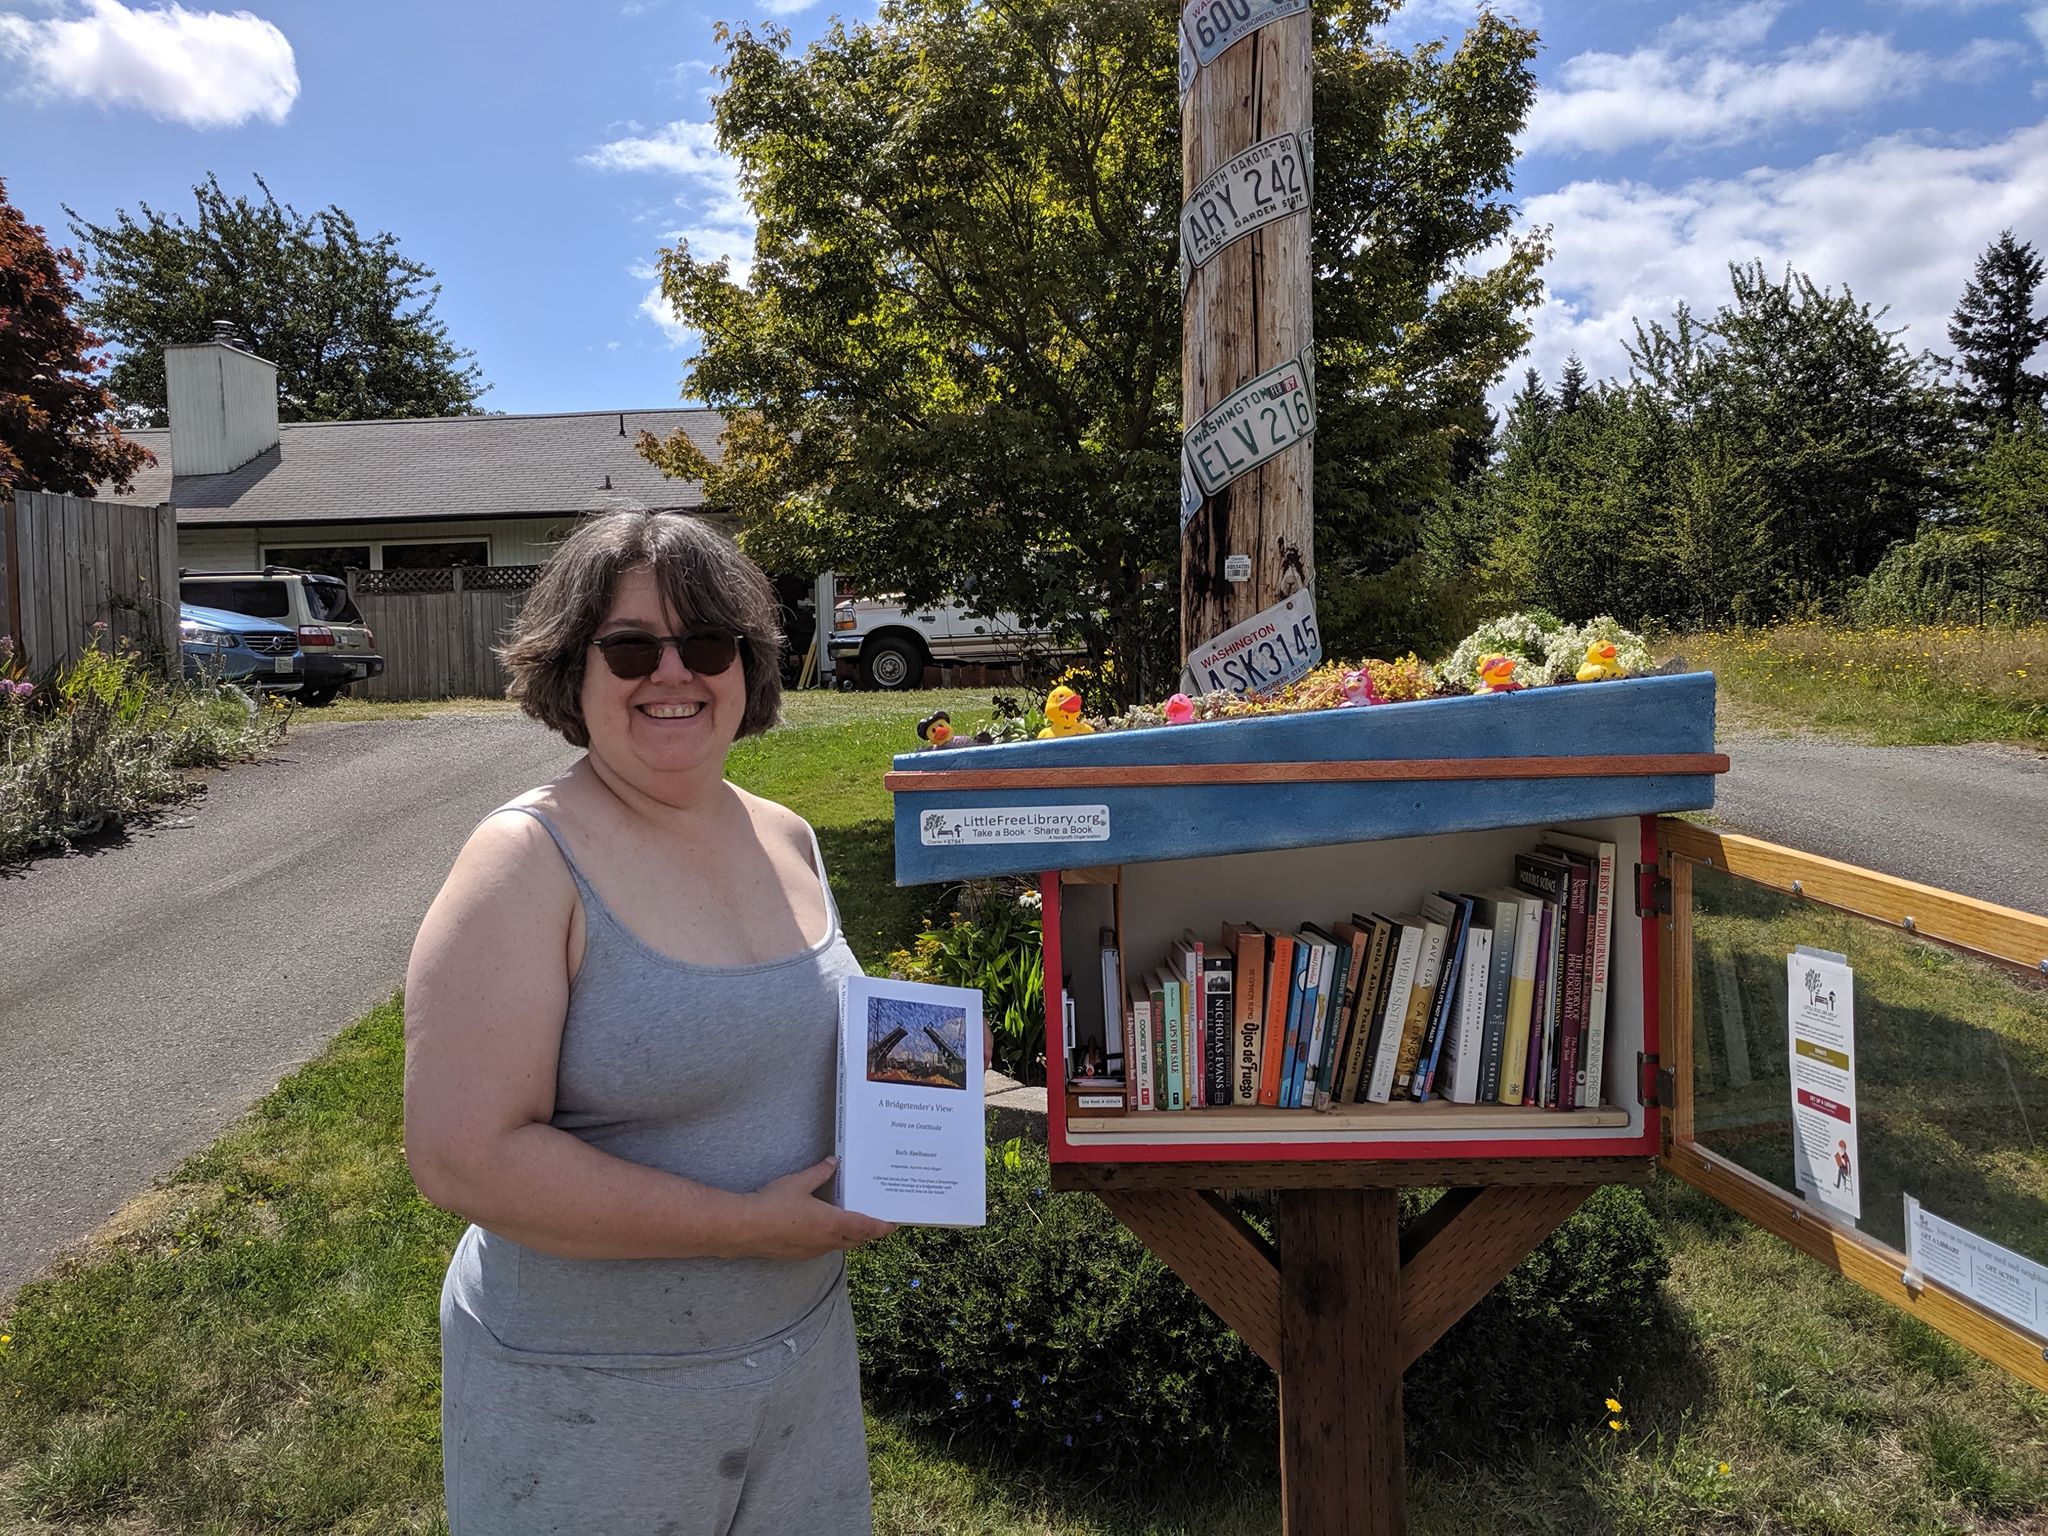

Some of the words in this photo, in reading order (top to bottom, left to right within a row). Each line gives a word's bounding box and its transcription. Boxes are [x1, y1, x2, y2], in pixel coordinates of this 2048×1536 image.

[1232, 10, 1275, 37] EVERGREEN
[1199, 171, 1228, 199] NORTH
[1231, 148, 1272, 174] DAKOTA
[1190, 183, 1238, 249] ARY
[1244, 154, 1301, 206] 242
[1198, 229, 1228, 256] PEACE
[1234, 203, 1277, 228] GARDEN
[1191, 387, 1270, 447] WASHINGTON
[1197, 419, 1259, 483] ELV
[1260, 390, 1309, 445] 216
[1201, 623, 1275, 669] WASHINGTON
[1208, 614, 1317, 694] ASK3145
[1291, 663, 1308, 678] STATE
[964, 813, 1100, 827] LittleFreeLibrary.org
[972, 828, 993, 838] Take
[1003, 827, 1025, 836] Book
[1034, 825, 1060, 836] Share
[1070, 825, 1093, 834] Book
[1600, 855, 1611, 874] THE
[1571, 879, 1580, 909] Newhall
[1578, 879, 1588, 914] Beaumont
[1599, 875, 1609, 895] BEST
[1598, 896, 1609, 908] OF
[1585, 914, 1596, 954] HENRY'S
[1373, 927, 1387, 972] Angela's
[1427, 937, 1440, 963] DAVE
[1499, 951, 1508, 974] SAND
[1575, 953, 1584, 971] THE
[1338, 973, 1347, 996] BELIEVE
[1366, 973, 1377, 1001] Ashes
[1395, 957, 1411, 995] WEIRD
[1422, 968, 1433, 990] ISAY
[1565, 953, 1576, 1020] PHOTOGRAPHY
[1573, 973, 1582, 1007] HISTORY
[1247, 1001, 1255, 1020] KING
[1465, 986, 1474, 1013] falling
[1475, 991, 1483, 1030] guterson
[1496, 992, 1504, 1008] FOG
[1555, 981, 1563, 1028] EXPERIMENTS
[1168, 1019, 1178, 1038] CAPS
[1215, 999, 1224, 1053] NICHOLAS
[1359, 1007, 1371, 1034] Frank
[1387, 996, 1403, 1039] SISTERS
[1572, 1009, 1580, 1020] OF
[1139, 1019, 1147, 1053] COOKIE'S
[1241, 1022, 1260, 1048] Ojos
[1405, 1001, 1426, 1062] CALLINGS
[1427, 1026, 1437, 1043] FAULT
[1170, 1041, 1178, 1054] FOR
[1243, 1049, 1256, 1064] de
[1351, 1037, 1364, 1075] McCourt
[1590, 1028, 1602, 1074] RUNNING
[1170, 1056, 1179, 1074] SALE
[1215, 1057, 1224, 1089] EVANS
[1381, 1058, 1391, 1086] ELEANOR
[1488, 1062, 1496, 1087] DUBUS
[1239, 1062, 1258, 1099] Fuego
[1587, 1075, 1599, 1103] PRESS
[885, 1100, 934, 1112] Bridgetender's
[936, 1104, 955, 1113] View:
[890, 1121, 907, 1129] Notes
[915, 1122, 942, 1131] Gratitude
